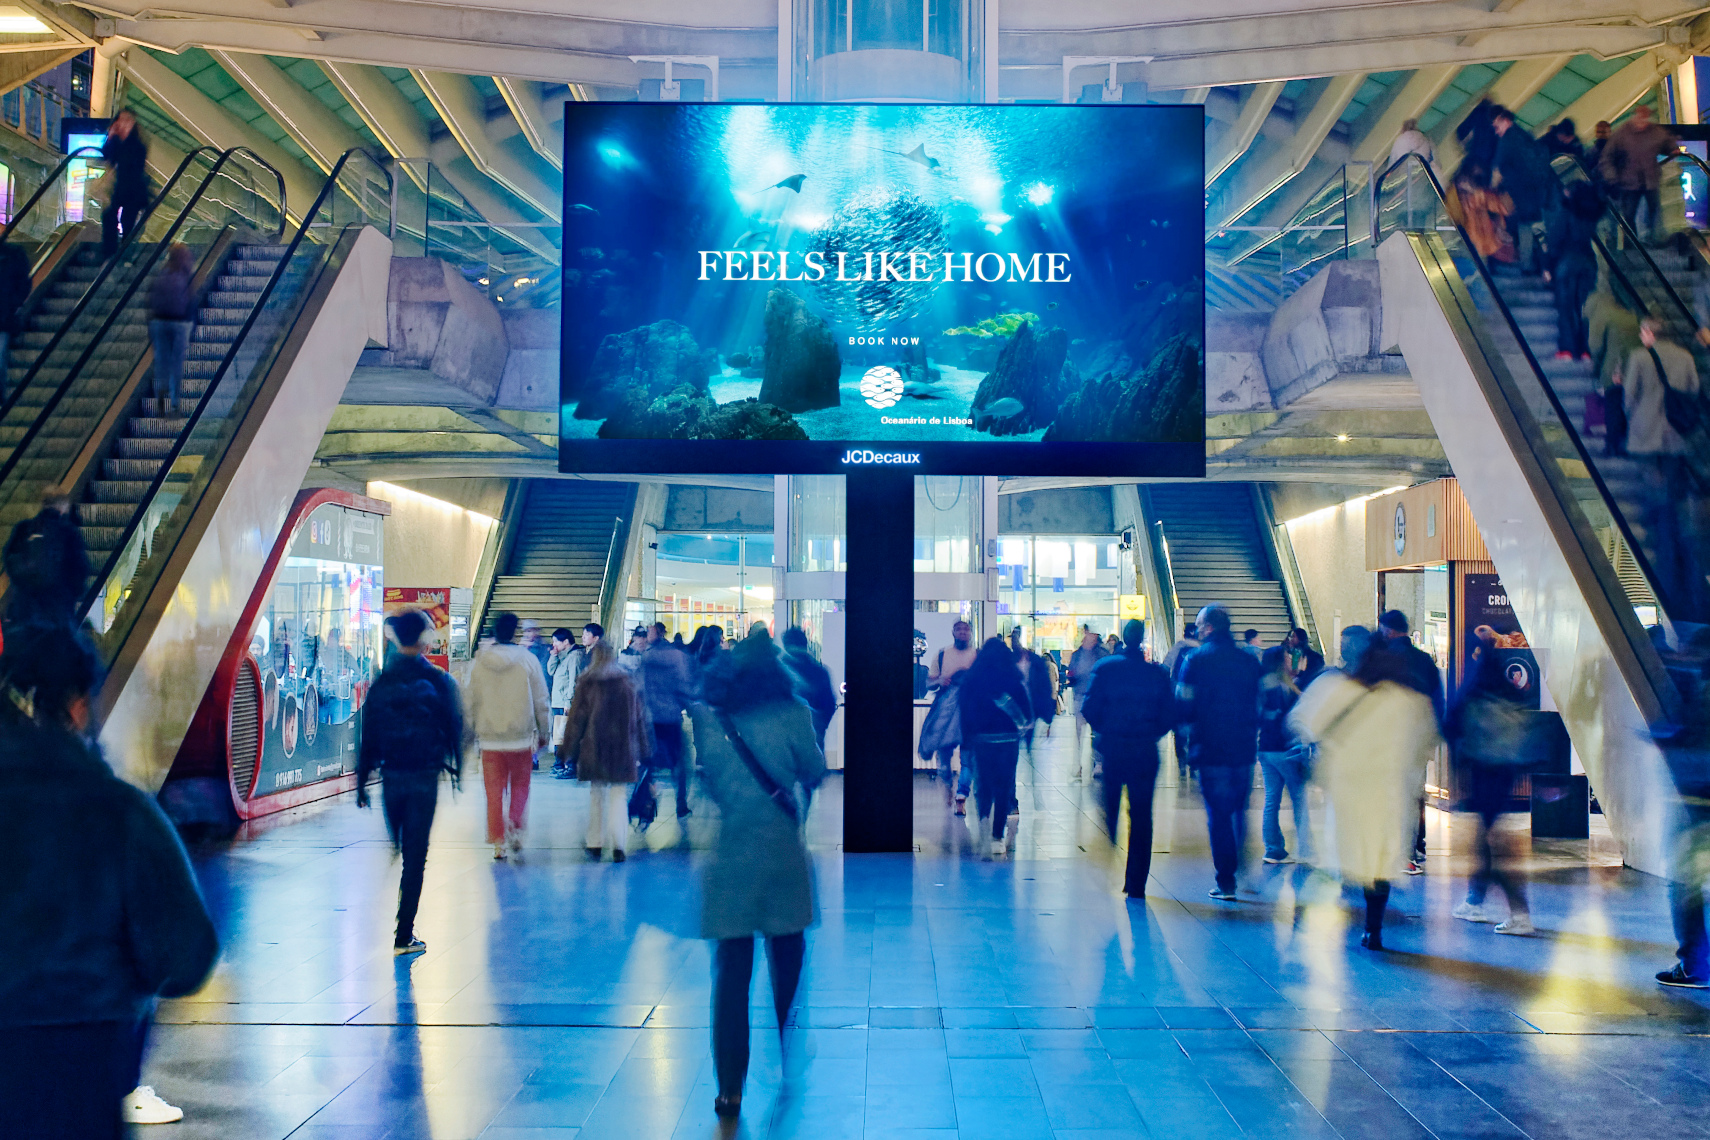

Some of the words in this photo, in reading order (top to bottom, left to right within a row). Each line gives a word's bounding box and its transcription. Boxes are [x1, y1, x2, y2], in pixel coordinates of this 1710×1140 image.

[697, 250, 826, 282] FEELS
[834, 250, 934, 283] LIKE
[942, 252, 1072, 283] HOME
[848, 336, 885, 346] BOOK
[891, 336, 920, 346] NOW
[880, 416, 927, 425] Oceanário
[929, 416, 941, 425] de
[943, 416, 973, 425] Lisboa
[841, 449, 921, 464] JCDecaux
